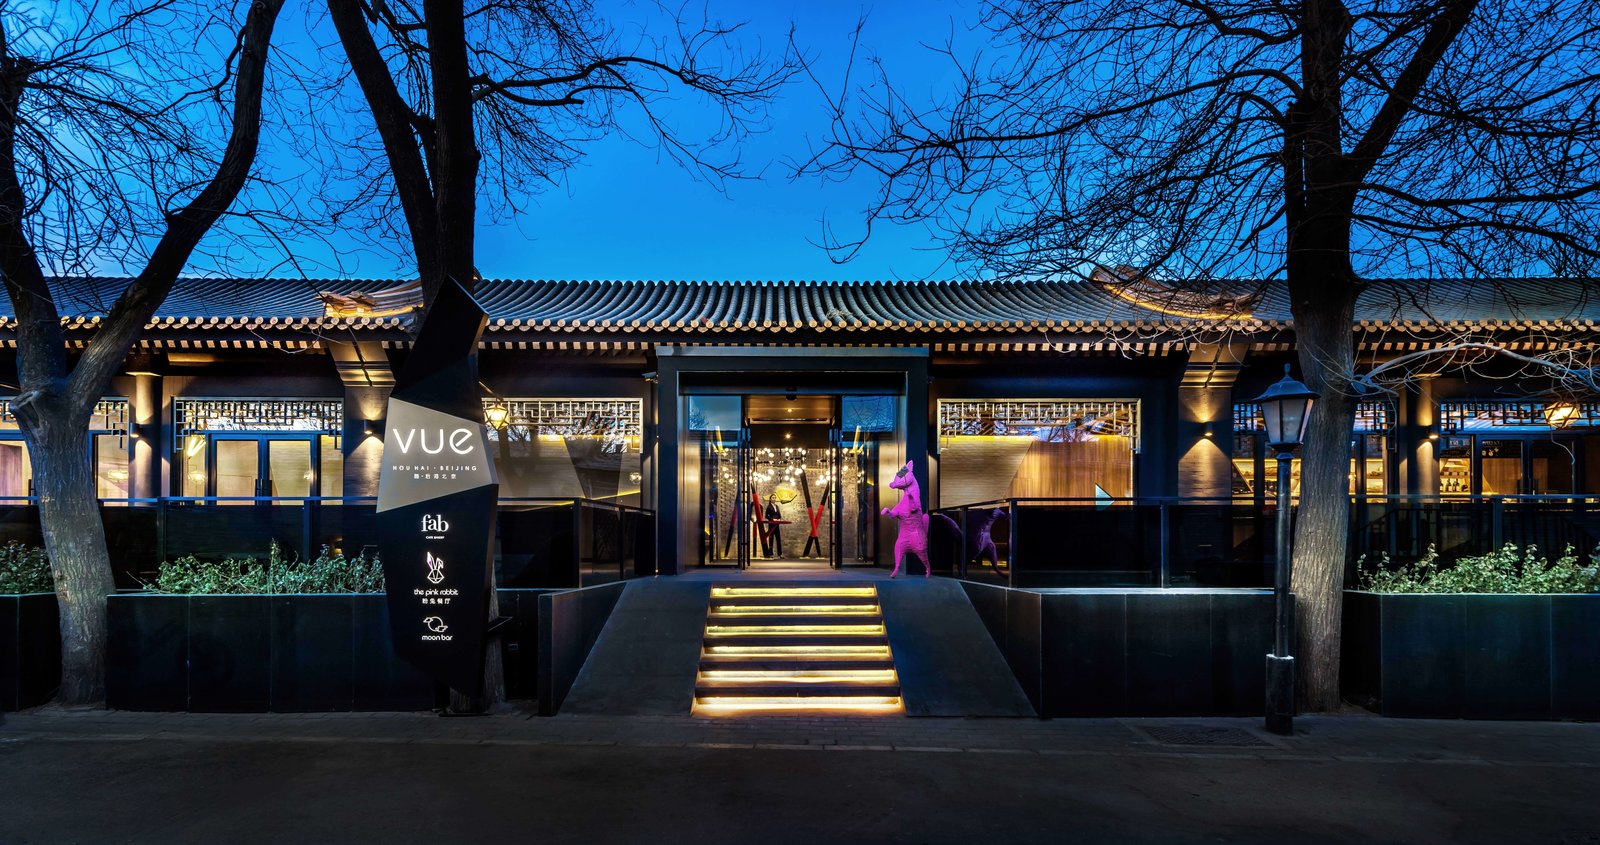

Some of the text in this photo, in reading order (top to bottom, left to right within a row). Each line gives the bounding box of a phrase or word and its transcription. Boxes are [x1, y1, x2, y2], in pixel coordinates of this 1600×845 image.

[420, 514, 449, 532] fab
[413, 588, 459, 597] the pink rabbit
[441, 633, 454, 641] bar
